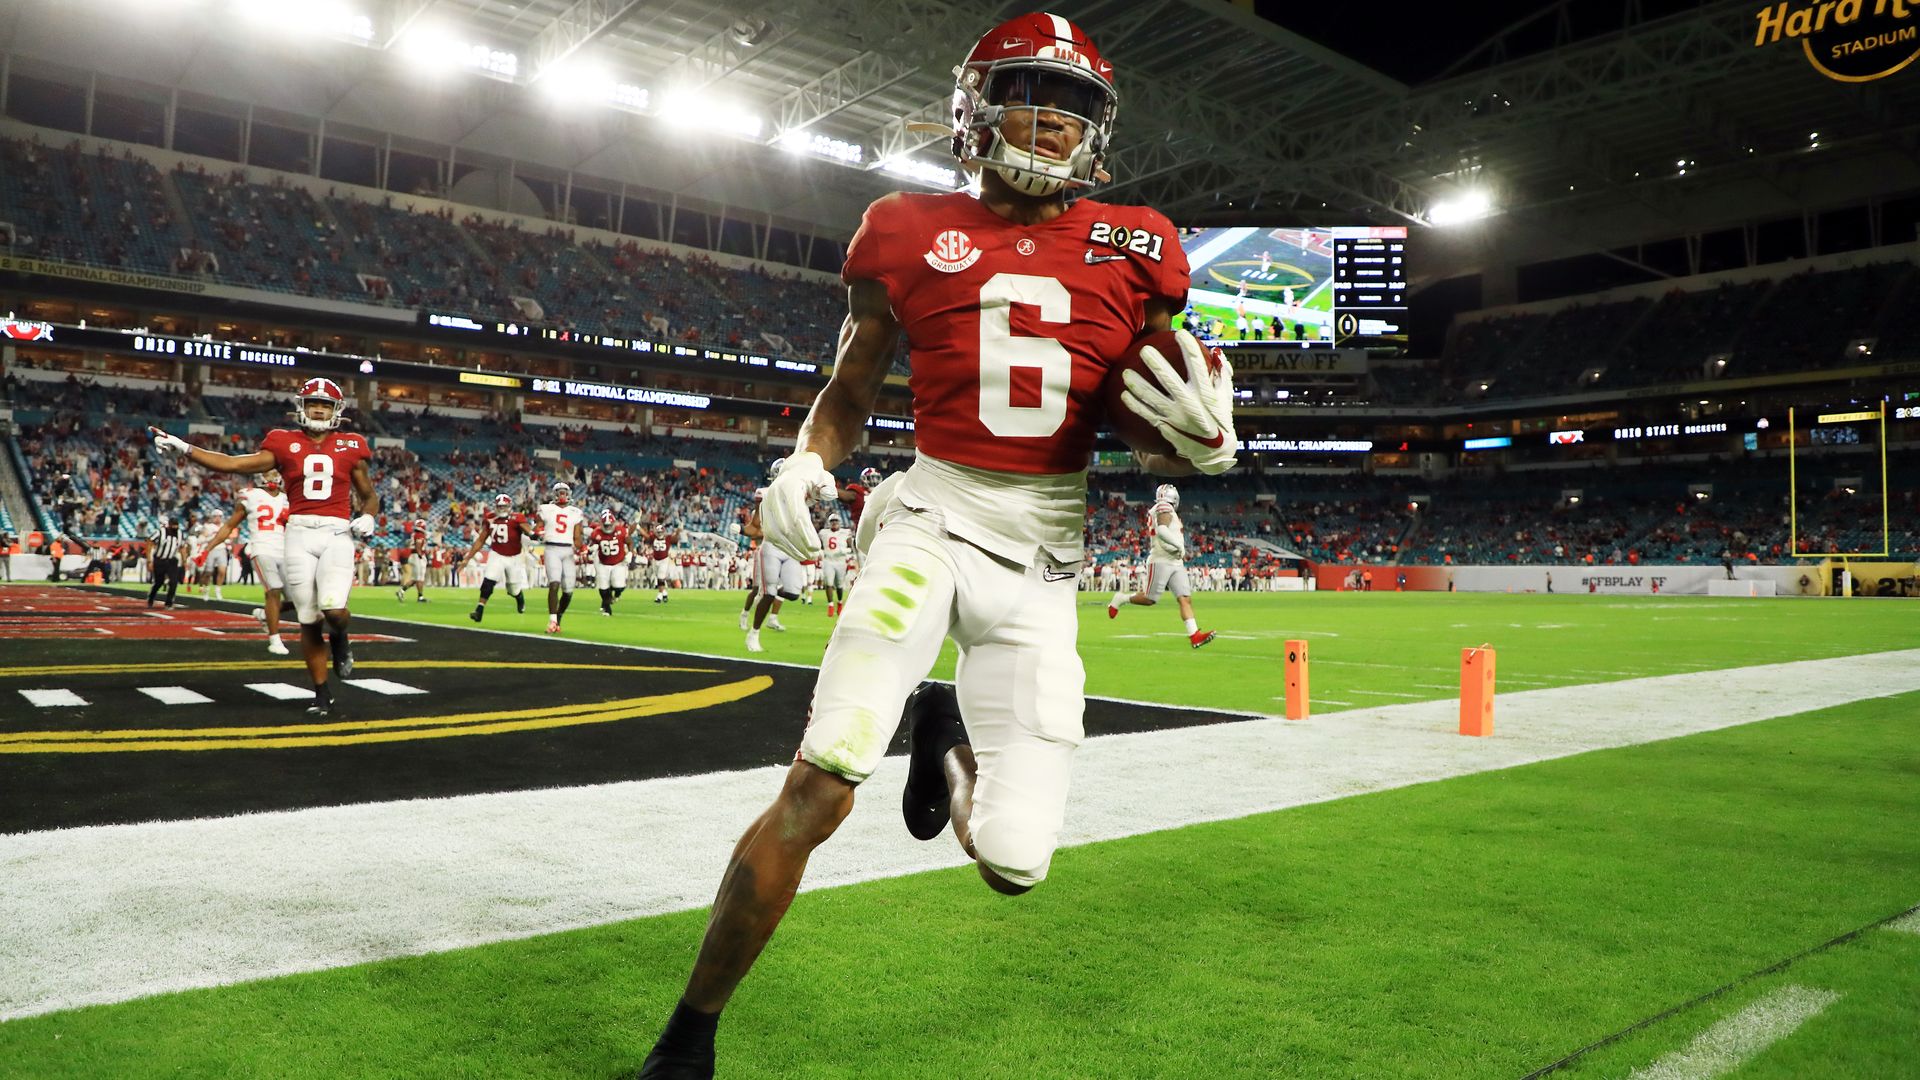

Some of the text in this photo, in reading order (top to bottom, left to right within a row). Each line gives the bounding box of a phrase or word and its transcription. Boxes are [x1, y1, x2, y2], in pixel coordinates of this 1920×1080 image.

[1755, 0, 1862, 47] Hard
[1832, 26, 1916, 58] STADIUM
[1054, 47, 1081, 64] BAMA
[936, 229, 972, 261] SEC
[1090, 222, 1163, 262] 2021
[931, 256, 975, 272] GRADUATE
[37, 263, 108, 281] NATIONAL
[109, 272, 206, 293] CHAMPIONSHIP
[134, 336, 295, 366] OHIO STATE BUCKEYES
[978, 272, 1072, 438] 6
[565, 382, 626, 400] NATIONAL
[626, 388, 710, 408] CHAMPIONSHIP
[1614, 423, 1727, 439] OHIO STATE BUCKEYES
[1248, 440, 1298, 451] NATIONAL
[1298, 441, 1373, 451] CHAMPIONSHIP
[303, 454, 334, 500] 8
[489, 523, 508, 544] 79
[555, 514, 568, 534] 5
[600, 539, 619, 556] 65
[828, 536, 837, 550] 6
